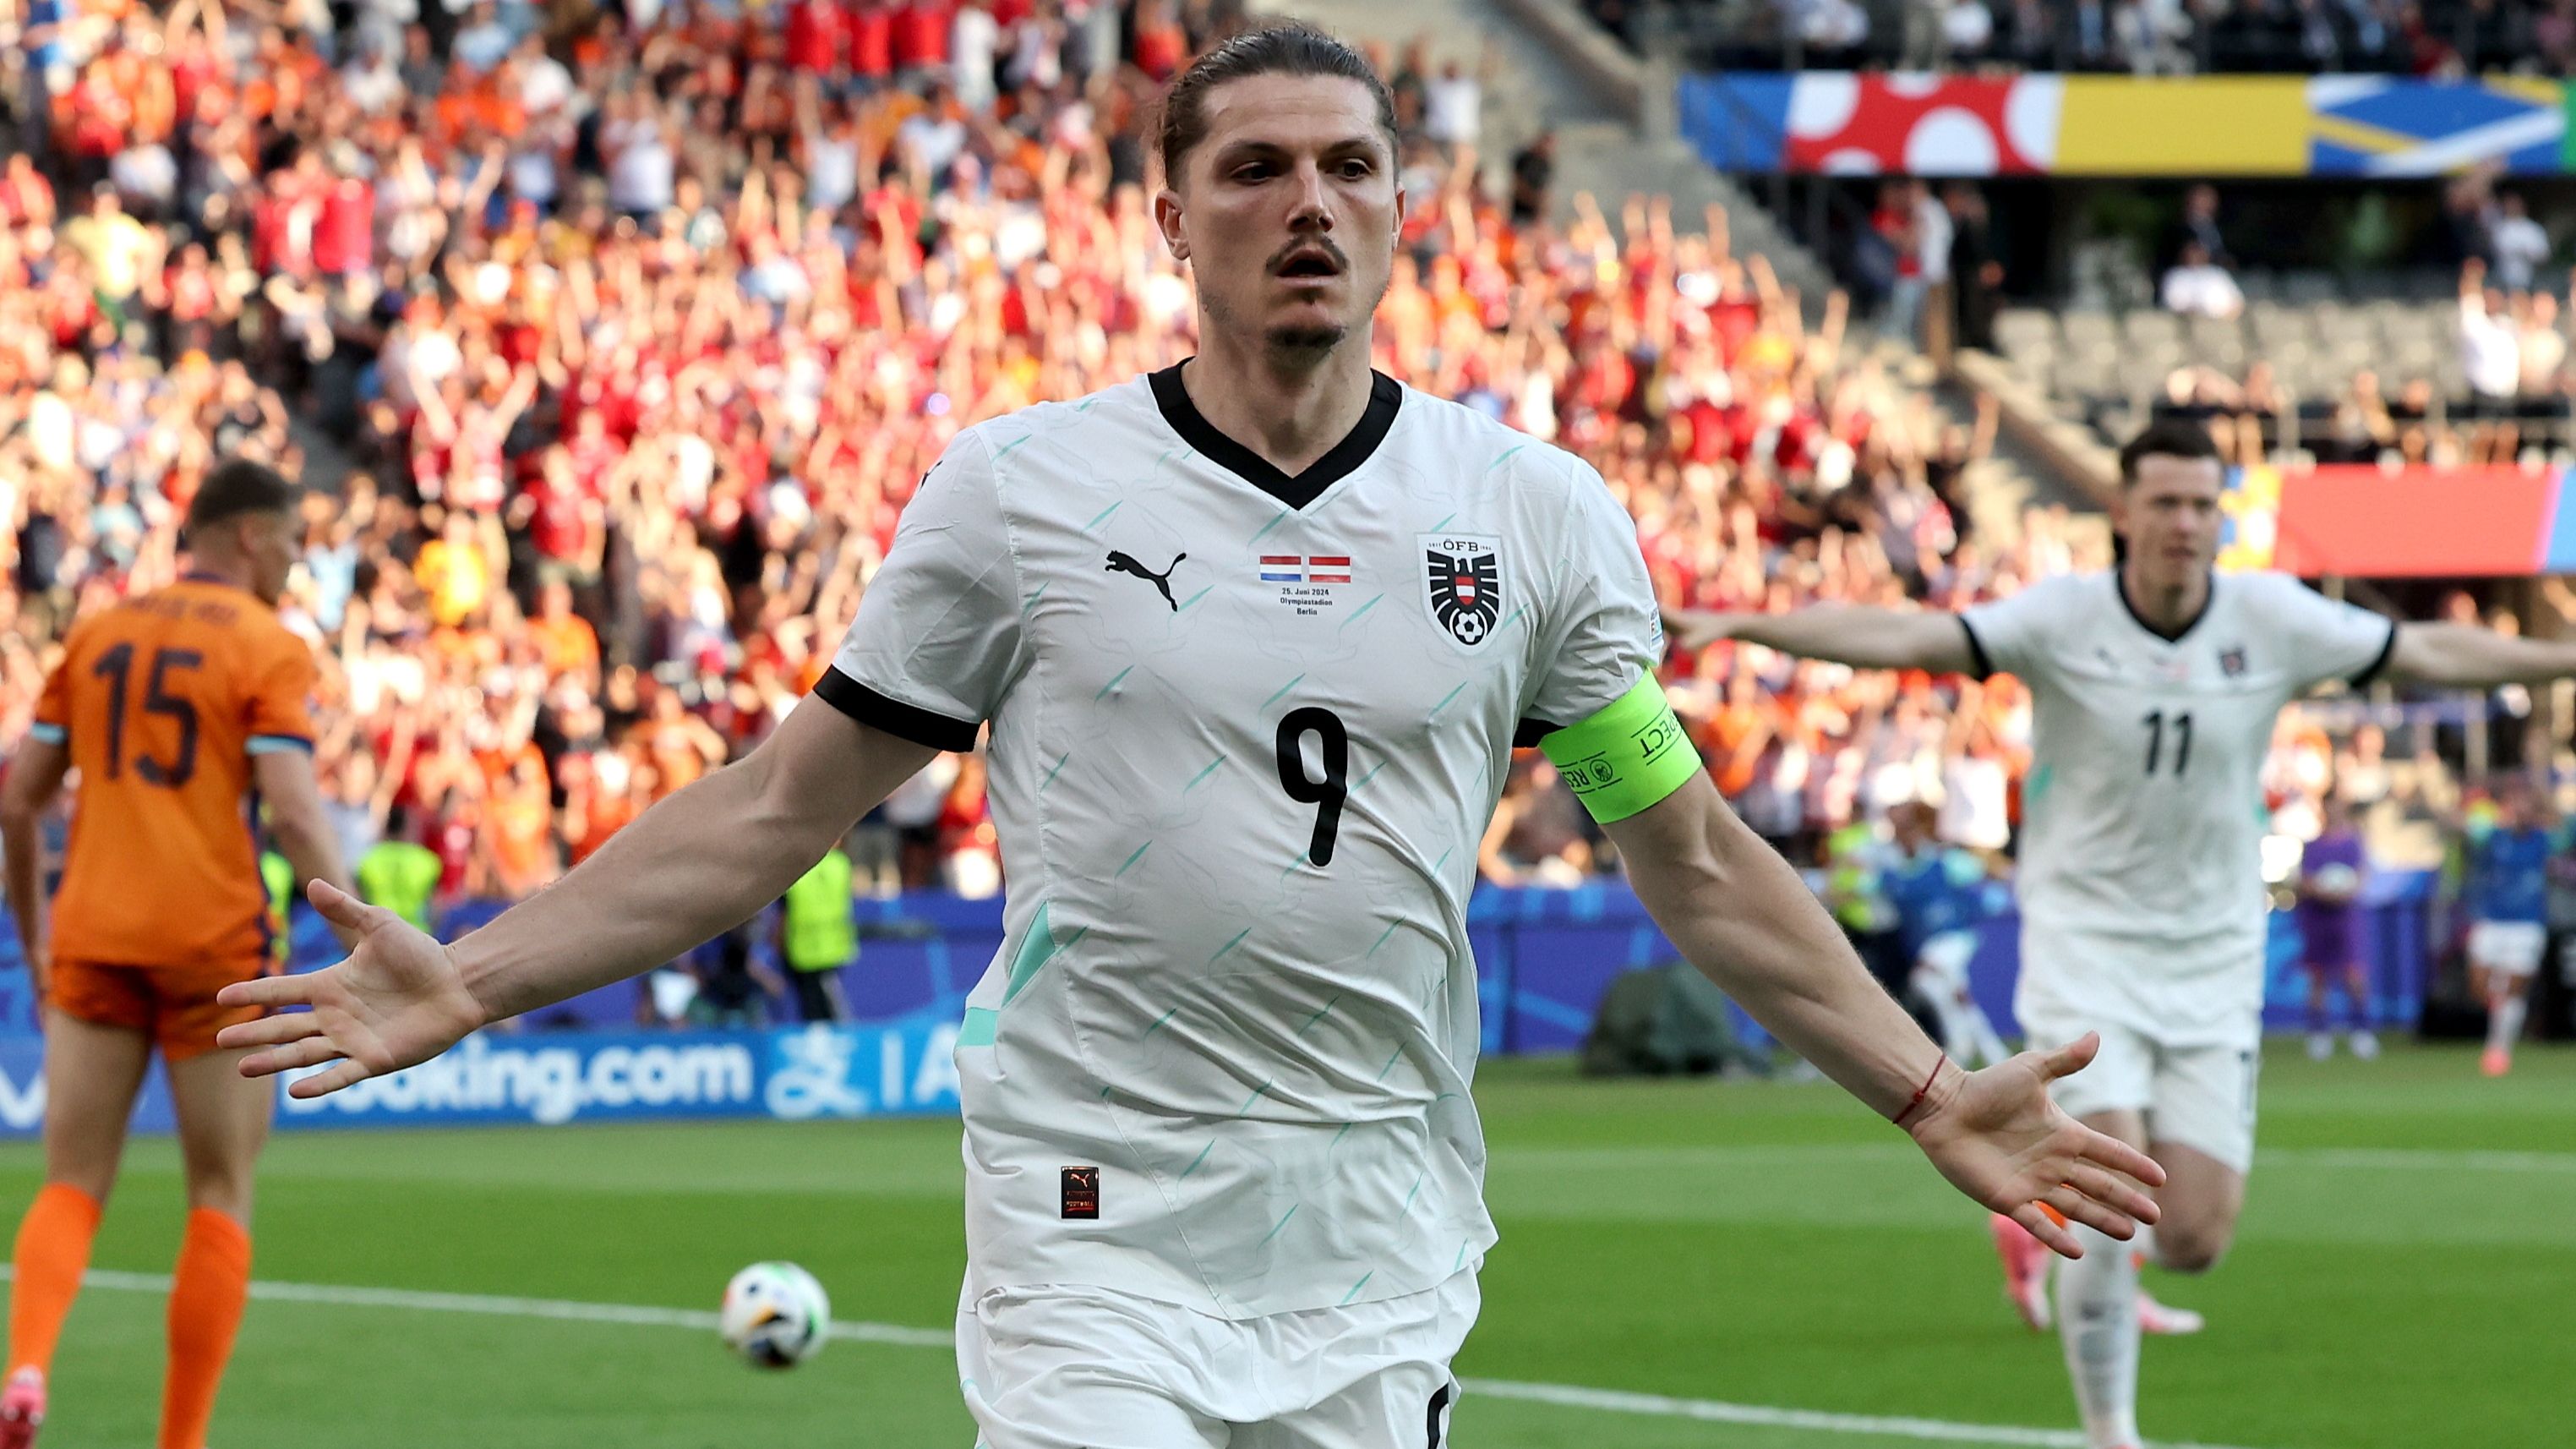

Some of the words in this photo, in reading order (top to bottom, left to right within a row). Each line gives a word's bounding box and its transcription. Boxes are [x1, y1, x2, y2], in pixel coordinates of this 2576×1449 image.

[1443, 538, 1478, 552] ÖFB
[1280, 597, 1333, 605] Olympiastadion
[1296, 607, 1318, 615] Berlin
[91, 640, 204, 790] 15
[2142, 709, 2191, 776] 11
[1275, 706, 1348, 867] 9
